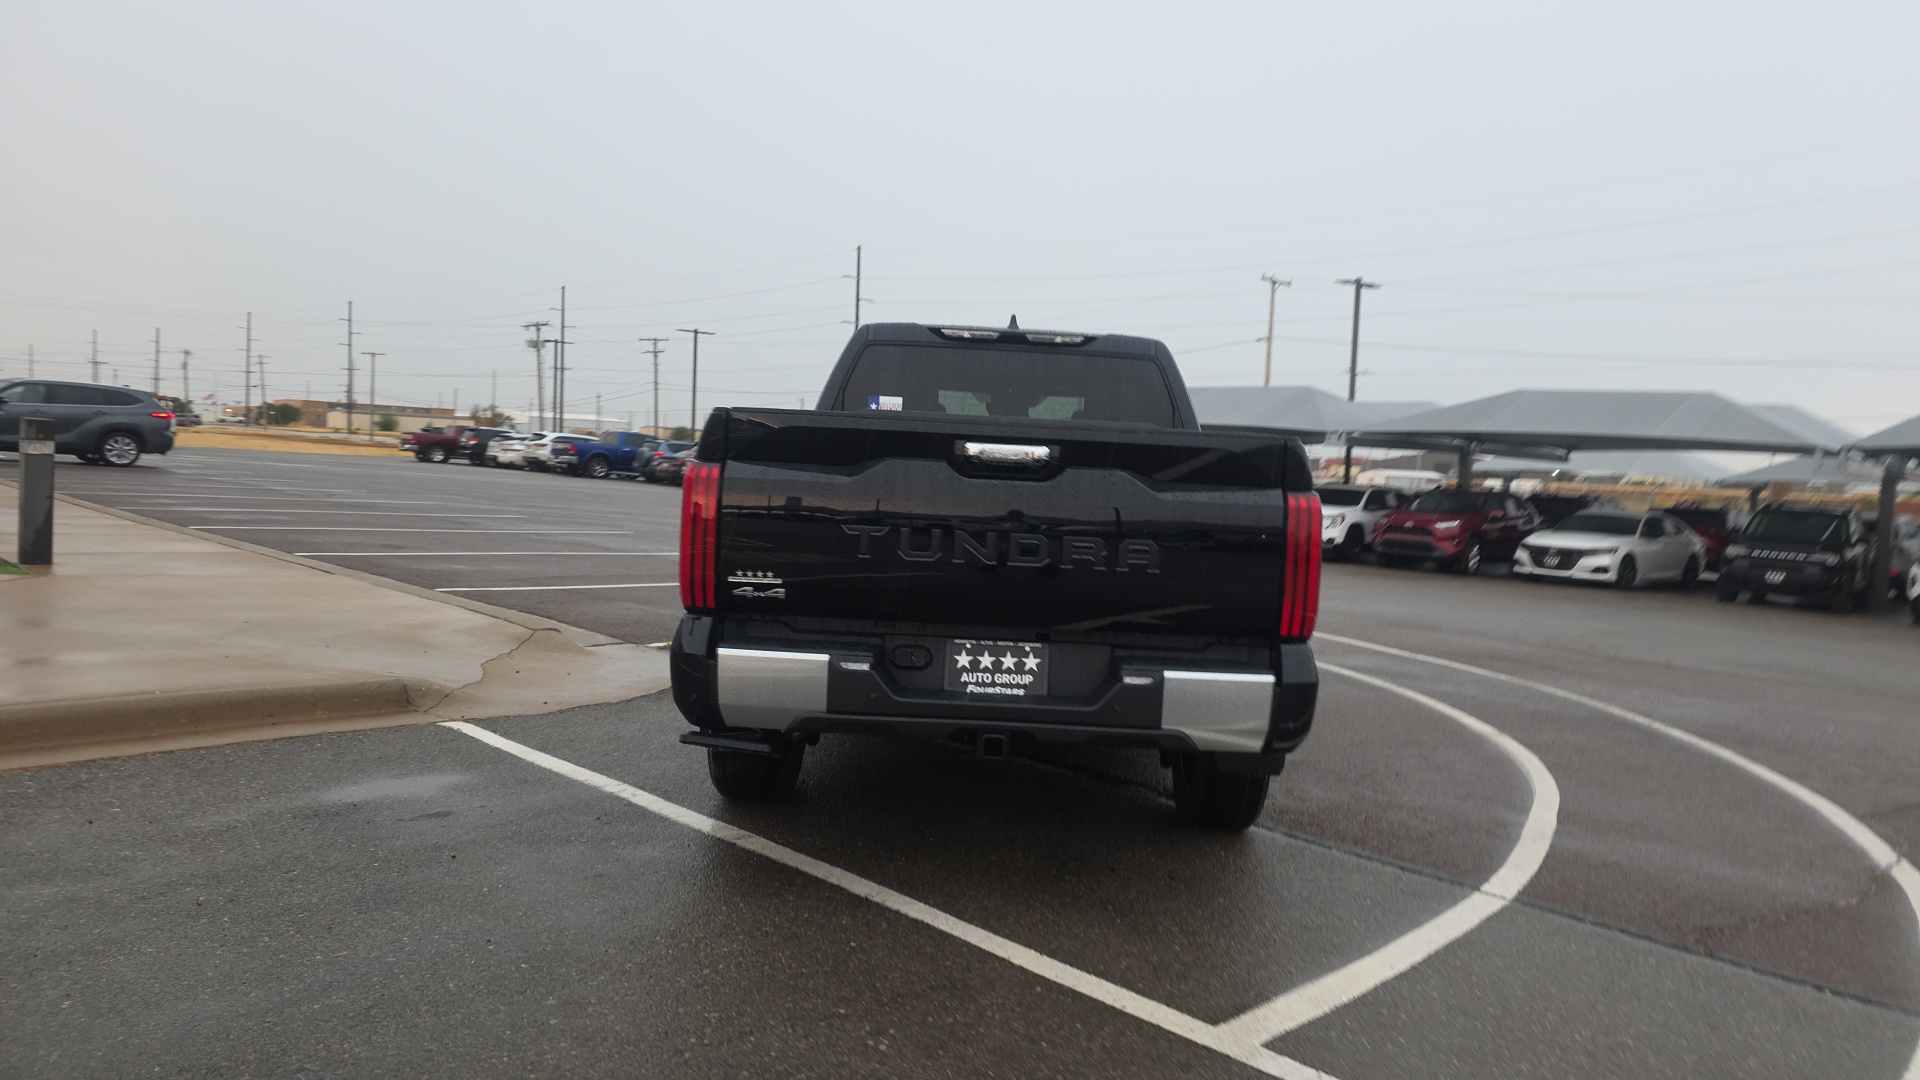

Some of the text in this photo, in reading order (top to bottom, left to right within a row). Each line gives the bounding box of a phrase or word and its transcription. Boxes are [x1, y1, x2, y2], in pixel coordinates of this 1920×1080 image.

[840, 524, 1160, 573] TUNDRA
[960, 672, 1034, 685] AUTO GROUP
